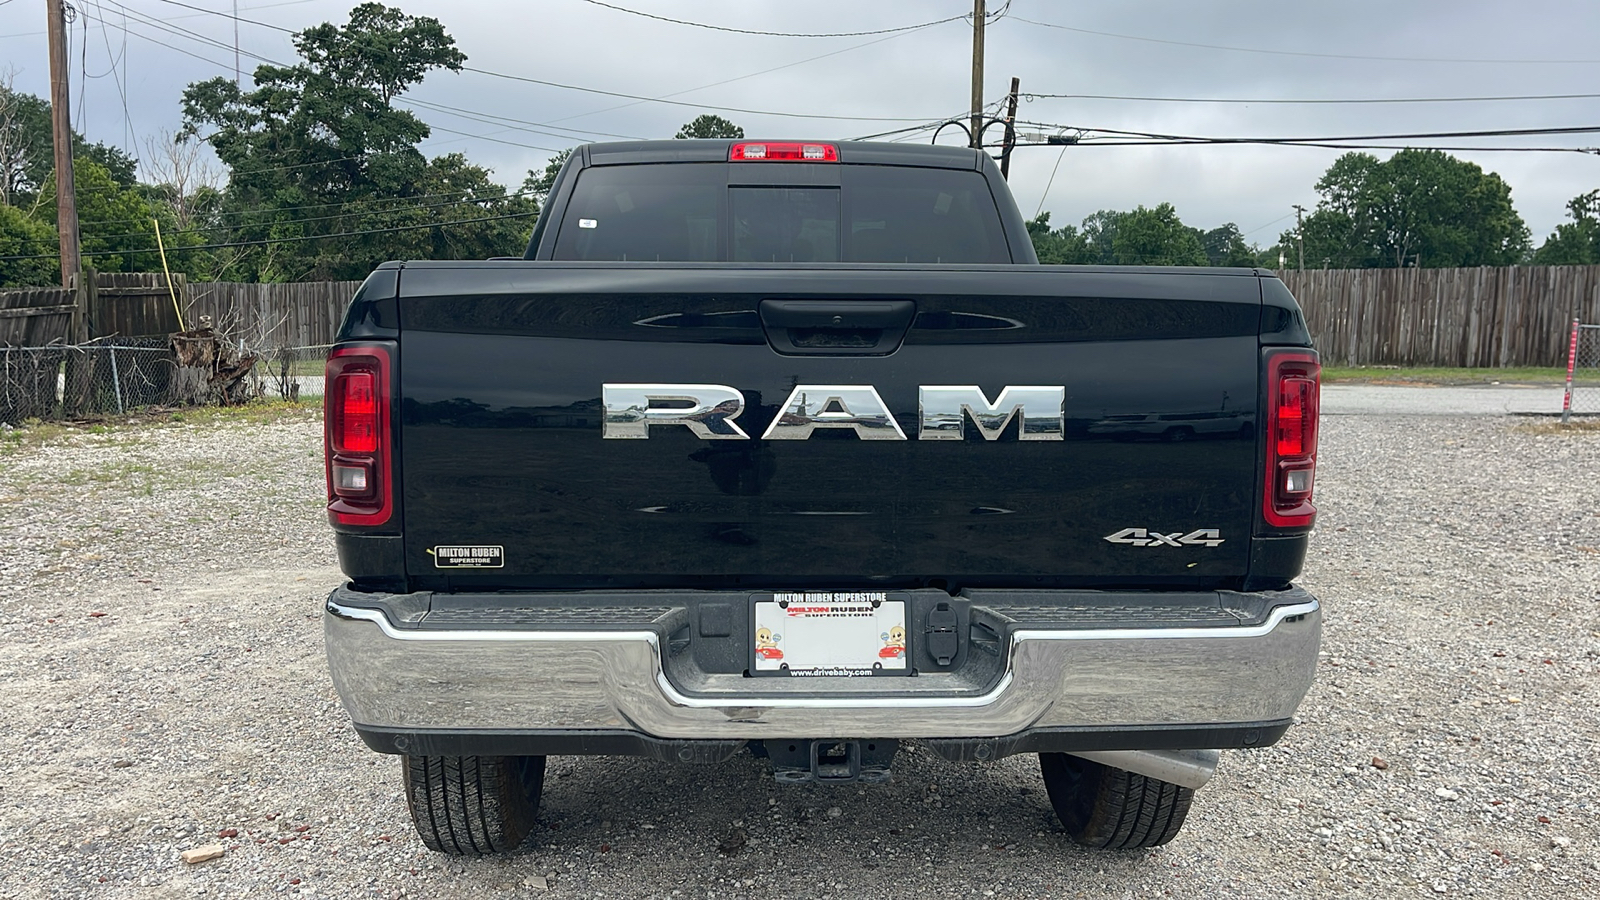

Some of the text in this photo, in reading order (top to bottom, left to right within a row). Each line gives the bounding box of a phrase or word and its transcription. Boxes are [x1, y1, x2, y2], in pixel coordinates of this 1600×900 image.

[602, 383, 1066, 441] RAM
[1103, 527, 1226, 547] 4x4
[438, 548, 500, 557] MILTON RUBEN
[774, 593, 886, 602] MILTON RUBEN SUPERSTORE
[790, 669, 872, 677] www.drivebaby.com
